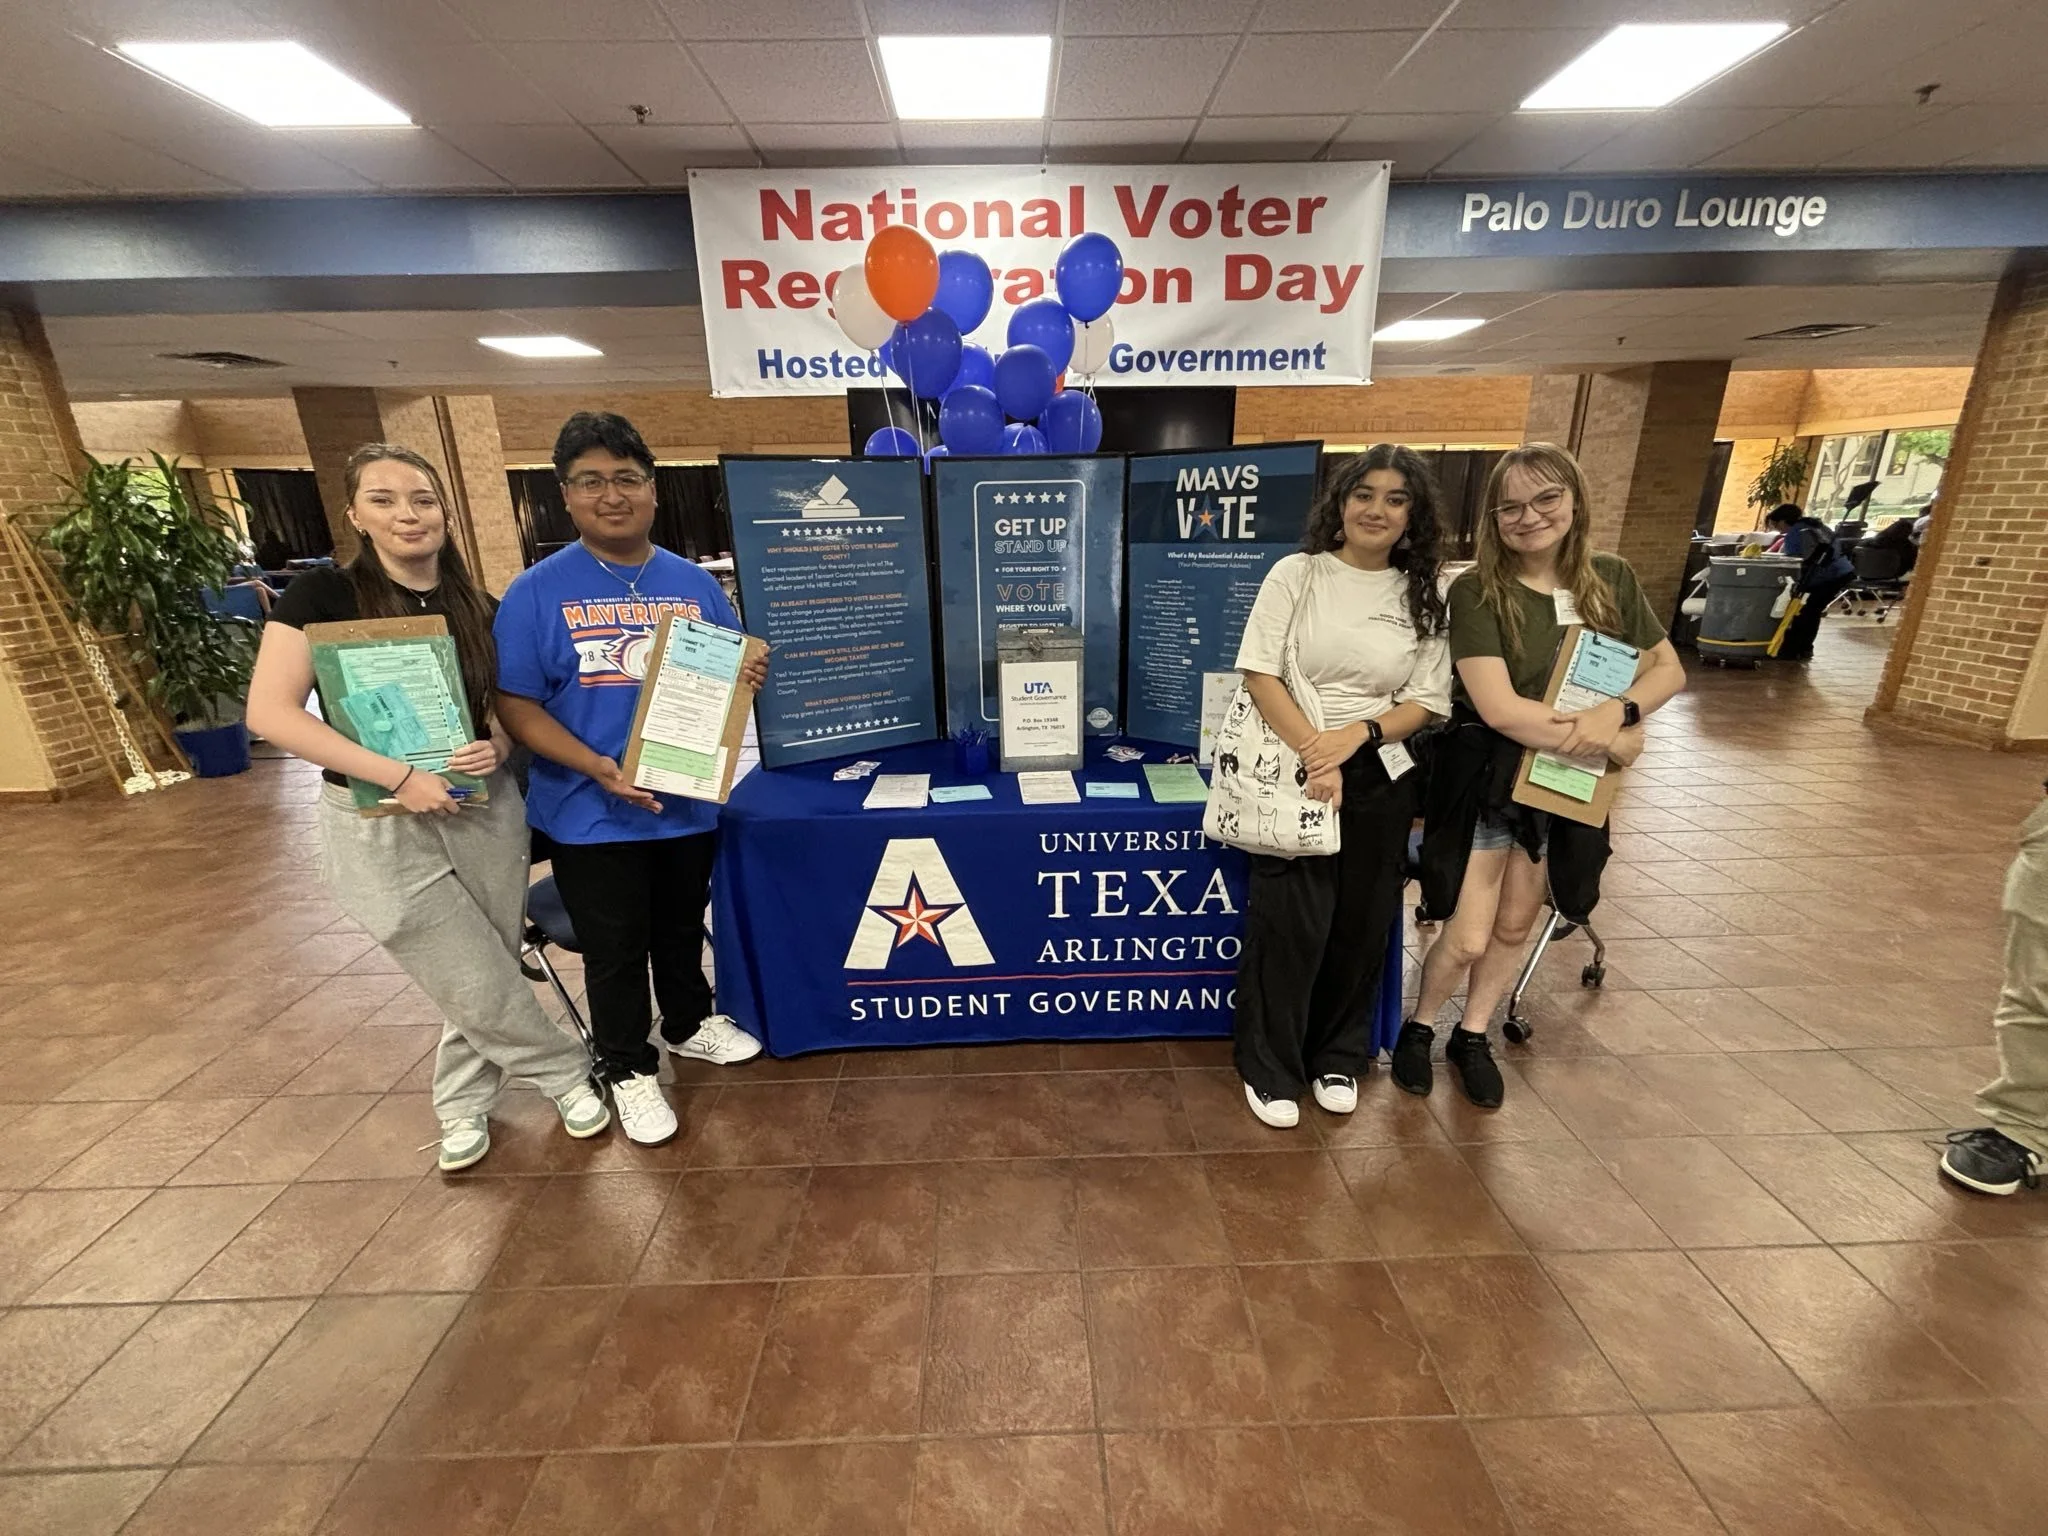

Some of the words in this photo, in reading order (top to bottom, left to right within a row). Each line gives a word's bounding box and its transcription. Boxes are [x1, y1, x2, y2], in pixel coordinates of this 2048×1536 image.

[759, 185, 1085, 241] National
[1113, 183, 1327, 240] Voter
[1461, 192, 1549, 234] Palo
[1563, 190, 1662, 230] Duro
[1674, 188, 1828, 236] Lounge
[1223, 252, 1363, 314] Day
[758, 346, 888, 379] Hosted
[1109, 340, 1327, 374] Government
[1176, 464, 1259, 492] MAVS
[995, 519, 1035, 536] GET
[1040, 518, 1066, 535] UP
[995, 540, 1044, 553] STAND
[1047, 540, 1067, 552] UP
[997, 583, 1064, 601] VOTE
[584, 651, 595, 662] 18
[1024, 682, 1053, 694] UTA
[1040, 830, 1230, 853] UNIVERSIT
[1038, 868, 1239, 918] TEXA
[1037, 935, 1242, 964] ARLINGTO
[851, 992, 1011, 1021] STUDENT
[1029, 987, 1236, 1014] GOVERNANC
